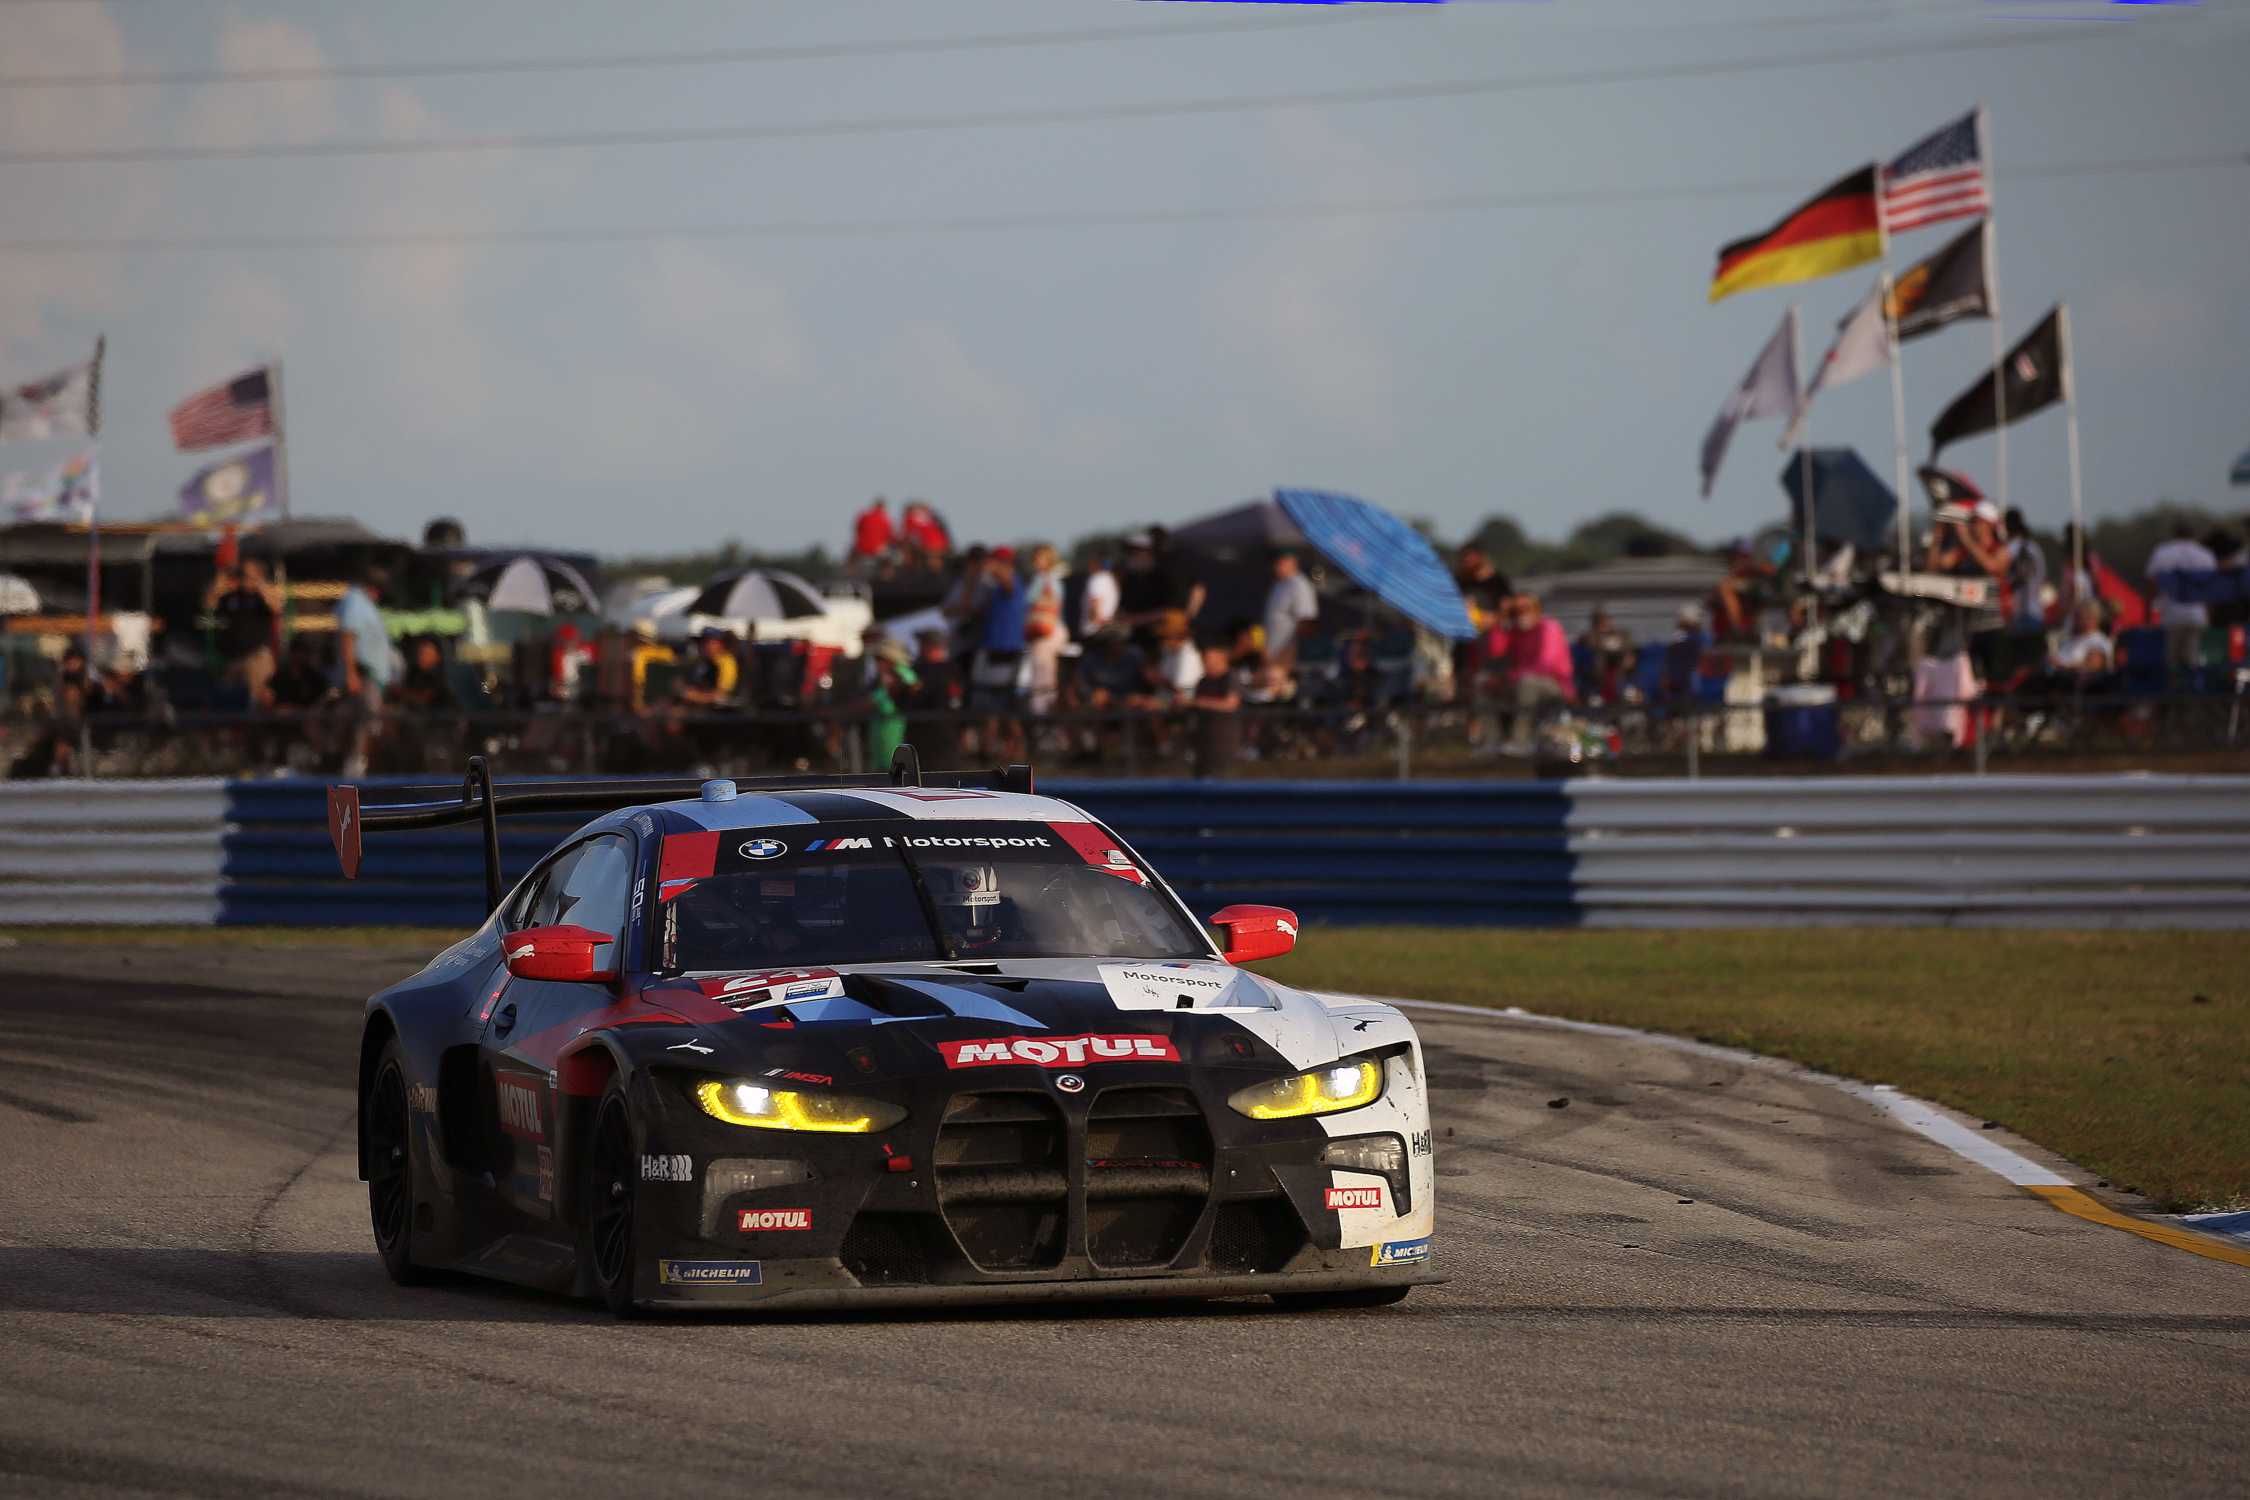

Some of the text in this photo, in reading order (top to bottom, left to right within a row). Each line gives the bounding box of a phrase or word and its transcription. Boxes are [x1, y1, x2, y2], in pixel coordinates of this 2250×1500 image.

[1122, 971, 1223, 989] Motorsport
[957, 1037, 1167, 1064] MOTUL
[1329, 1190, 1379, 1206] MOTUL
[742, 1212, 808, 1228] MOTUL
[683, 1268, 751, 1278] MICHELIN
